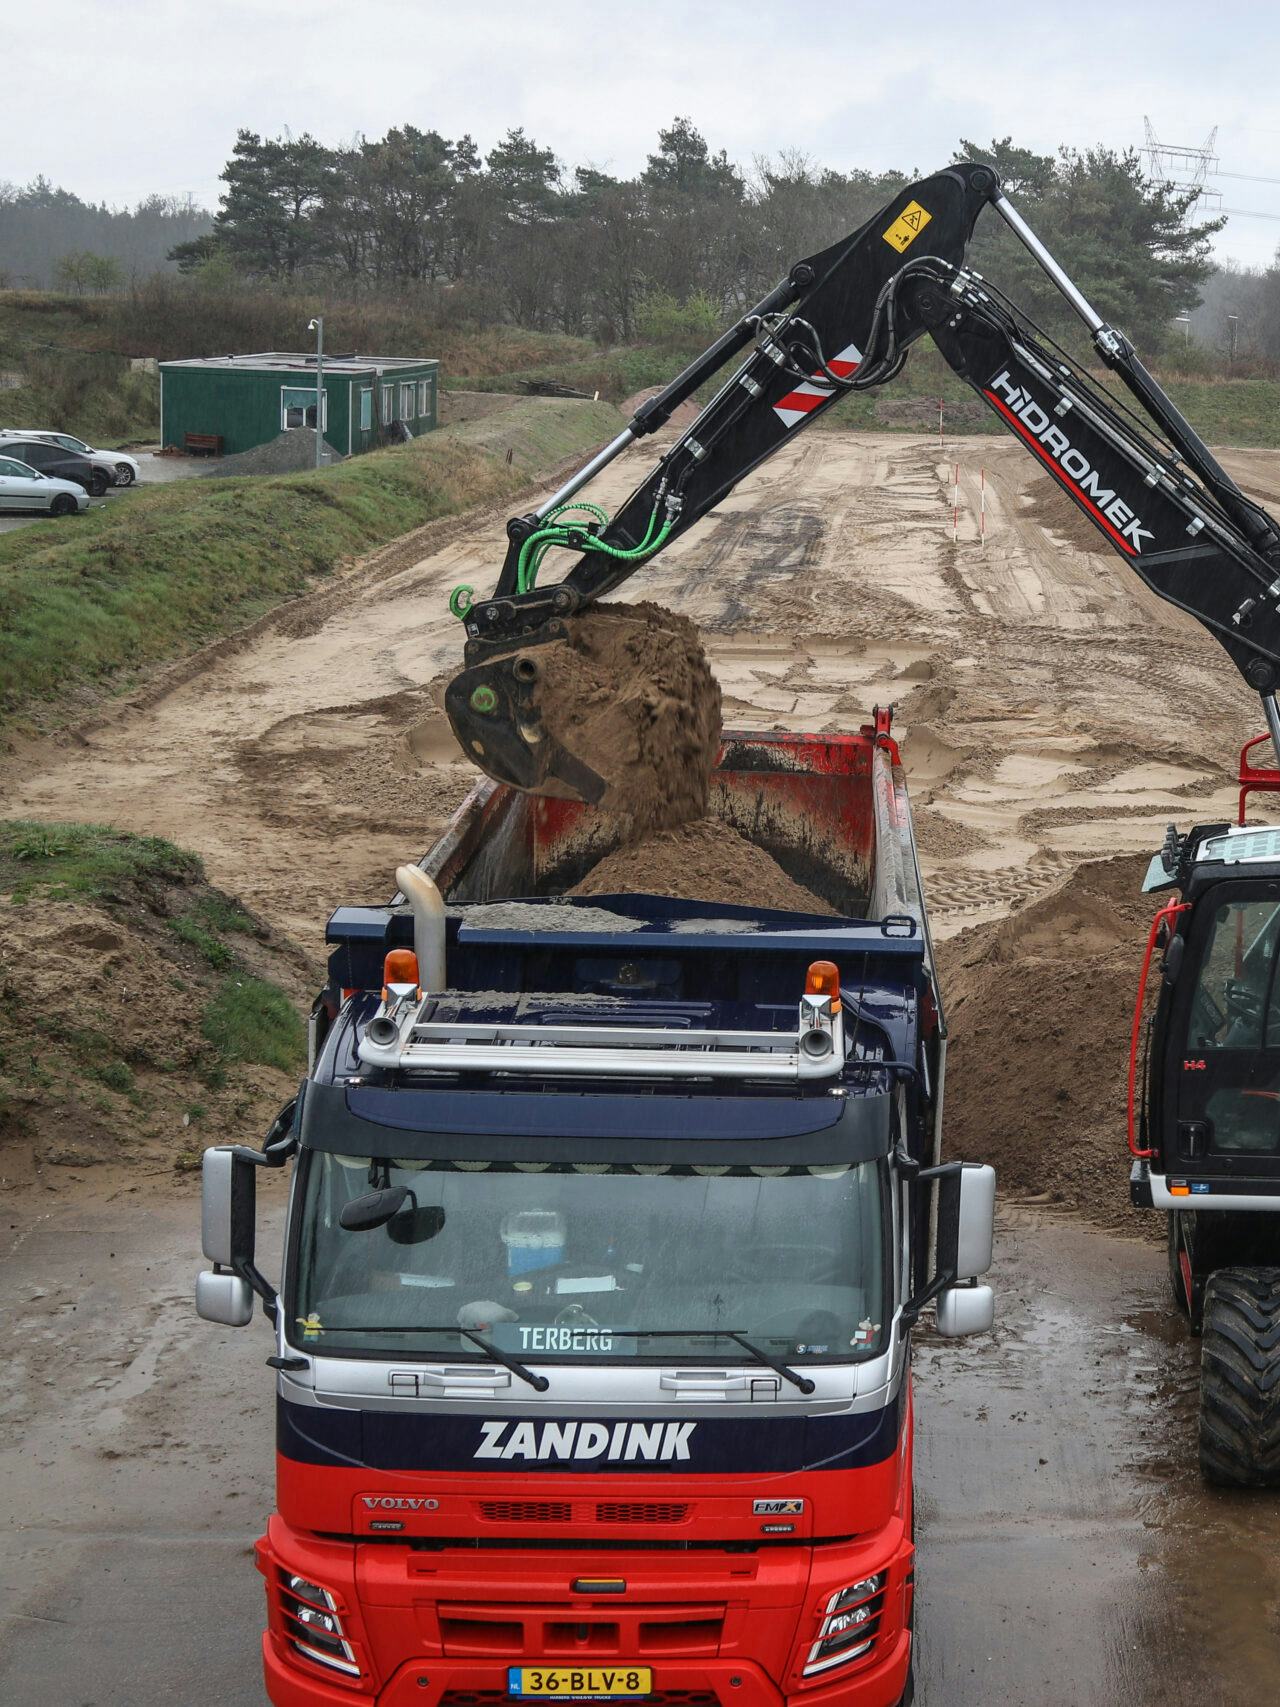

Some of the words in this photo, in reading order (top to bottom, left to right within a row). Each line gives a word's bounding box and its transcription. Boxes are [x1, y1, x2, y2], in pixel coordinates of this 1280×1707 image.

[1184, 1060, 1206, 1070] H4
[519, 1327, 613, 1351] TERBERG
[473, 1421, 698, 1461] ZANDINK
[361, 1497, 439, 1510] VOLVO
[530, 1672, 640, 1691] 36-BLV-8
